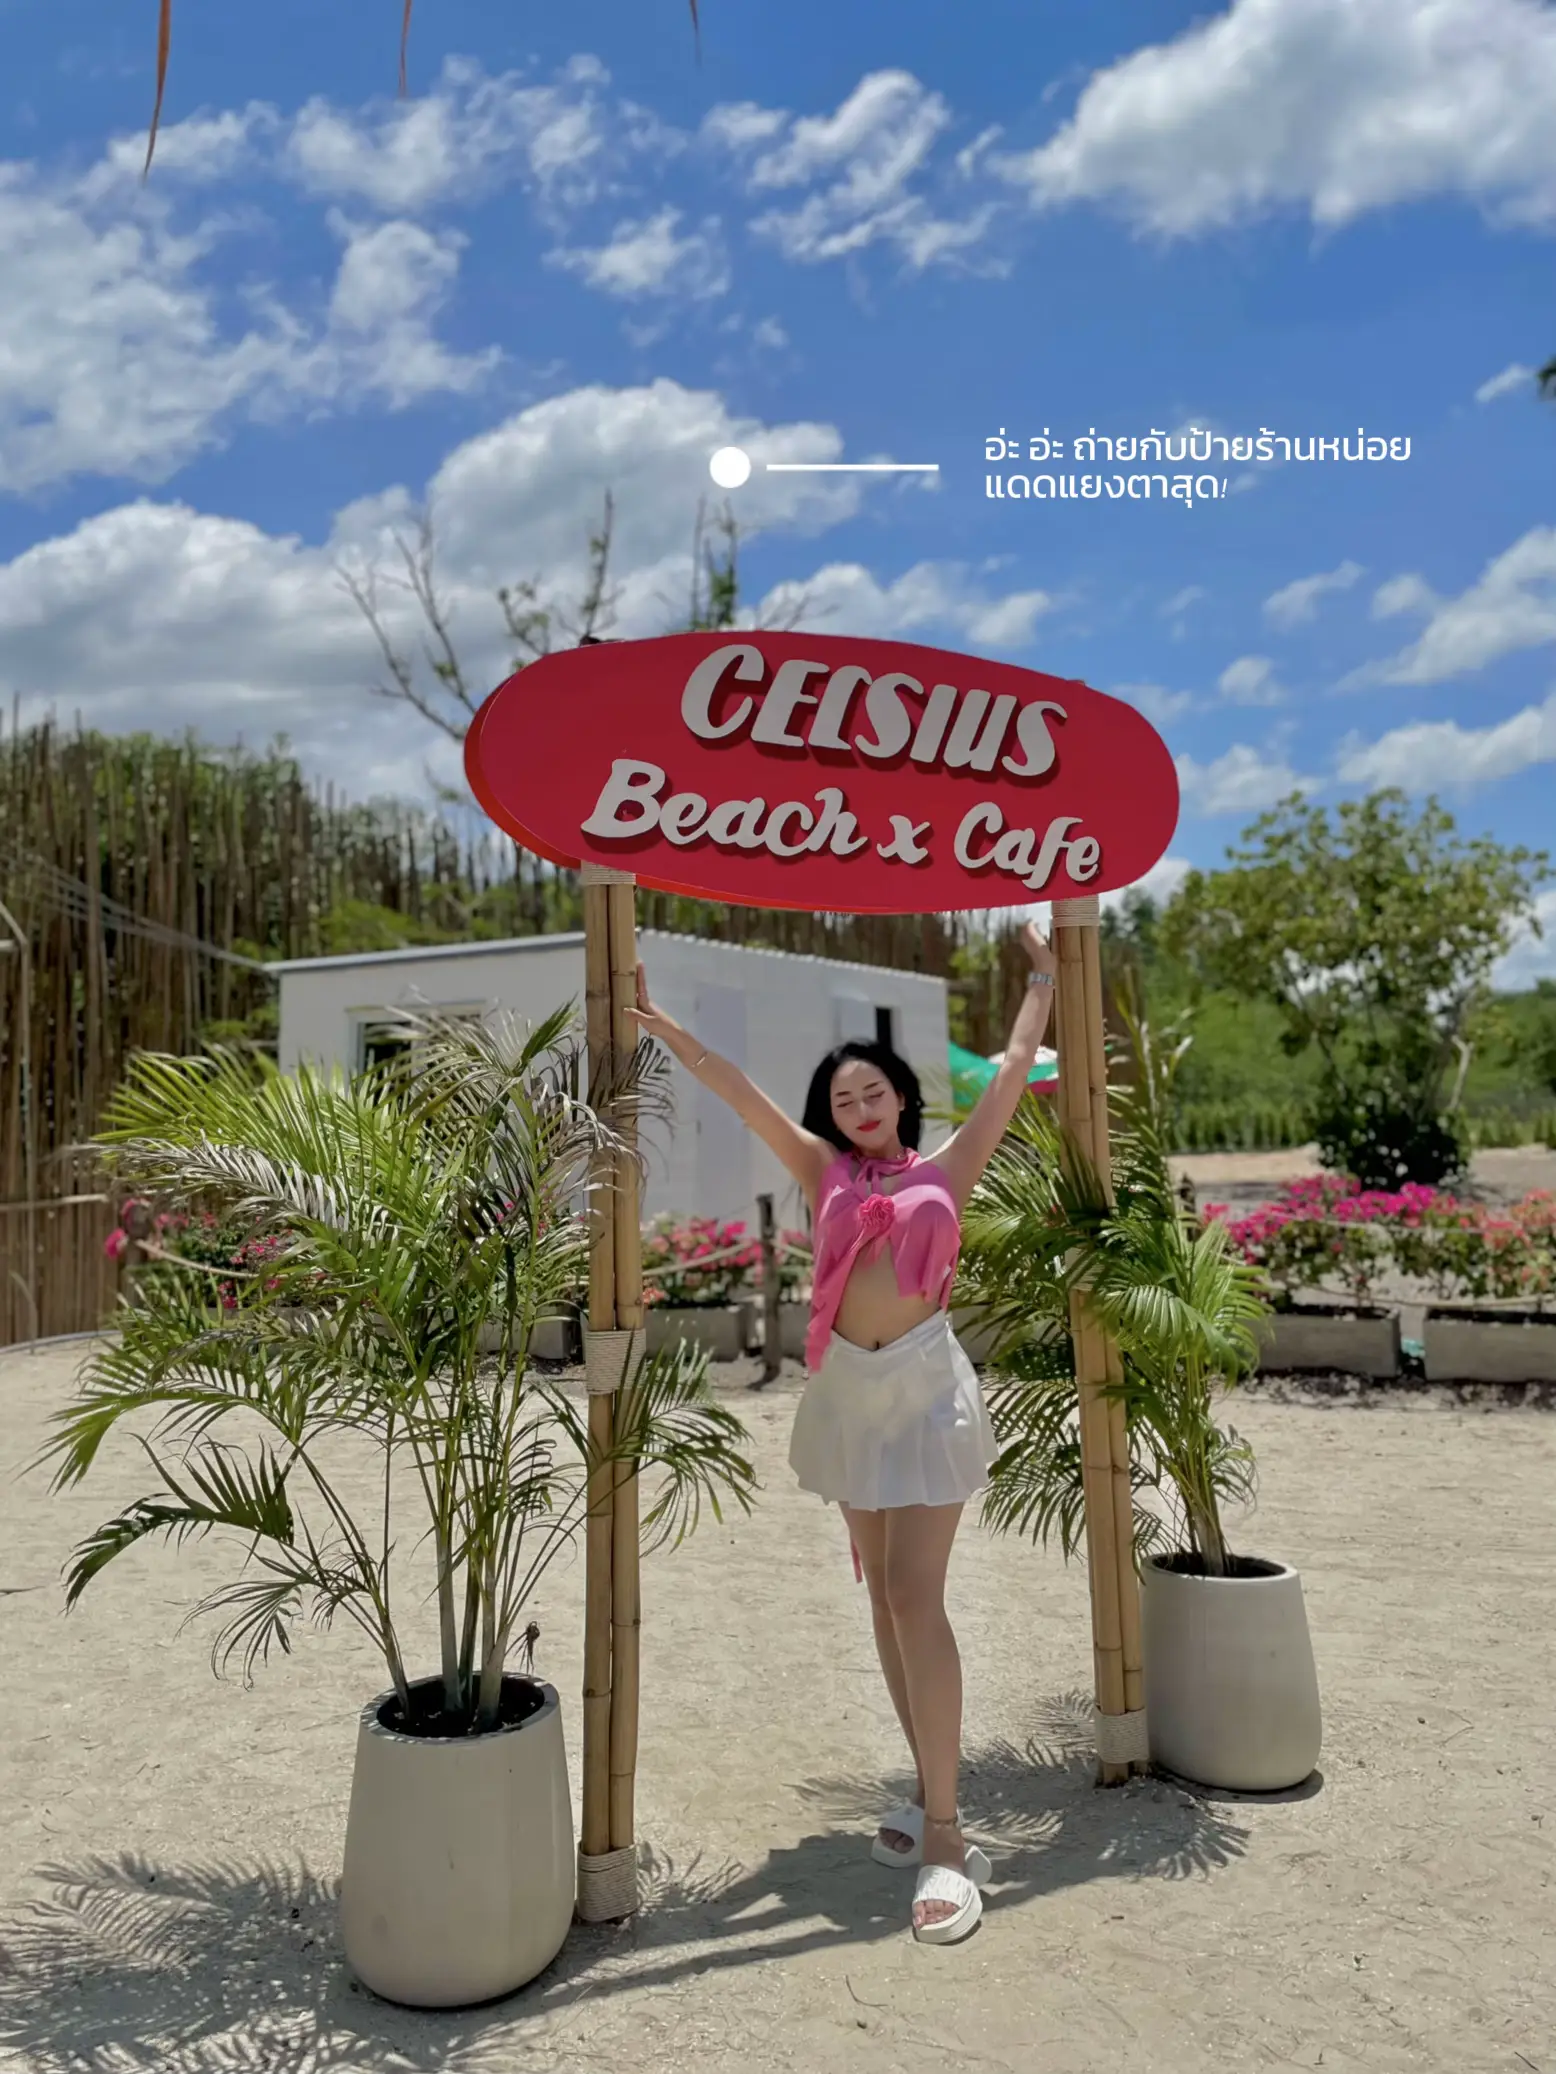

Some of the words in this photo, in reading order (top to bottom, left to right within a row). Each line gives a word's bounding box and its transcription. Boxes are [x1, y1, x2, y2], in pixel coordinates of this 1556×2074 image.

[680, 643, 1068, 777] CELSIUS
[580, 758, 868, 857] Beach
[876, 814, 931, 864] x
[954, 801, 1100, 890] Cafe
